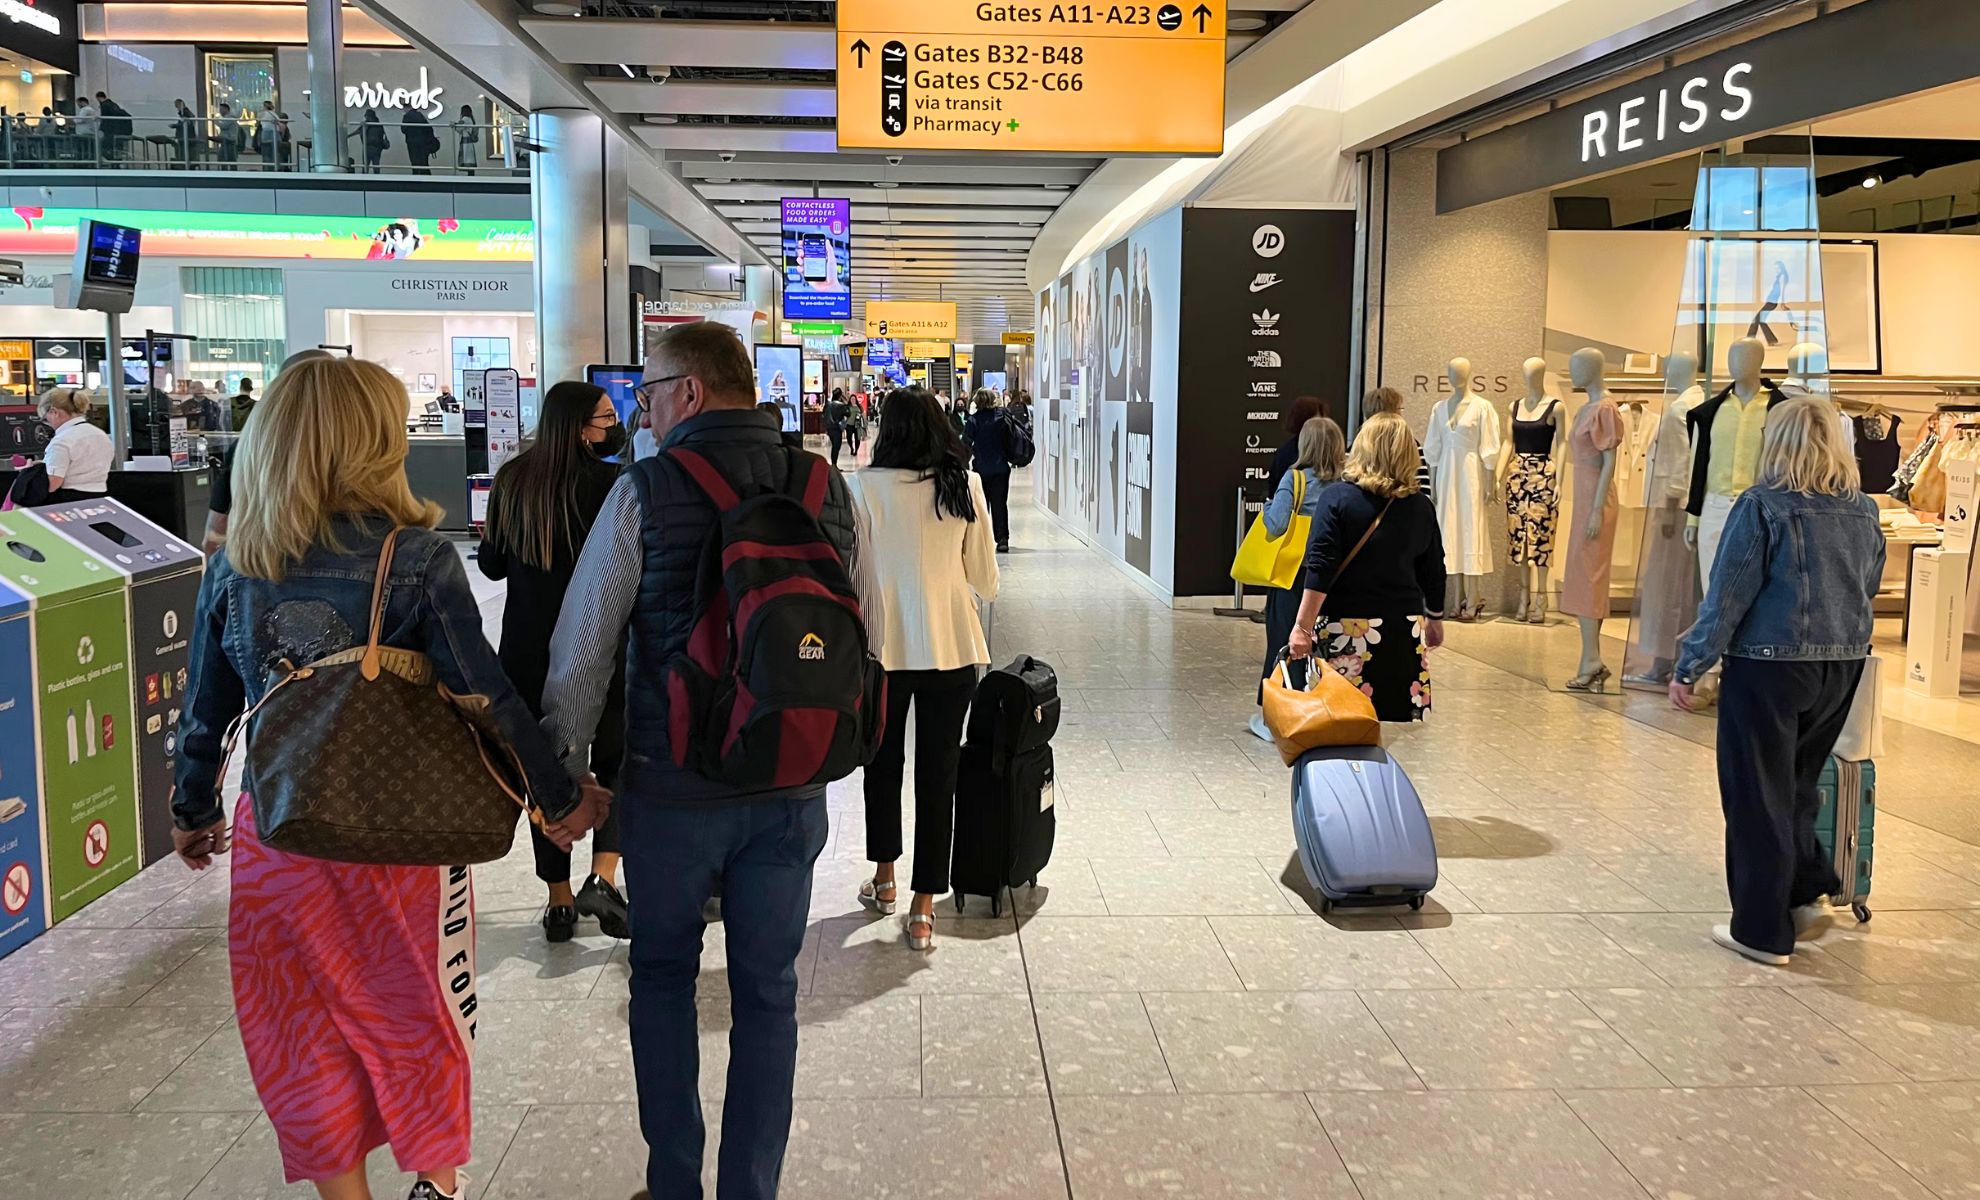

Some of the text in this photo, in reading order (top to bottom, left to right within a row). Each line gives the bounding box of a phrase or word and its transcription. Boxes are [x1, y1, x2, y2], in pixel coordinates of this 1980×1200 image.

[976, 2, 1151, 26] Gates A11-A23
[914, 43, 1084, 65] Gates B32-B48
[914, 70, 1084, 92] Gates C52-C66
[344, 65, 444, 120] arrods
[915, 95, 1002, 111] via transit
[1580, 62, 1753, 163] REISS
[913, 116, 1002, 136] Pharmacy
[1256, 232, 1280, 249] JD
[391, 279, 509, 291] CHRISTIAN DIOR
[1254, 273, 1277, 284] NIKE
[437, 292, 466, 301] PARIS
[1251, 328, 1280, 336] adidas
[1251, 382, 1277, 392] VANS
[1413, 375, 1508, 393] RESS
[1245, 467, 1270, 479] FIL
[1950, 475, 1971, 484] REISS
[1245, 502, 1264, 512] UM
[47, 681, 66, 694] Plastic
[101, 664, 112, 675] and
